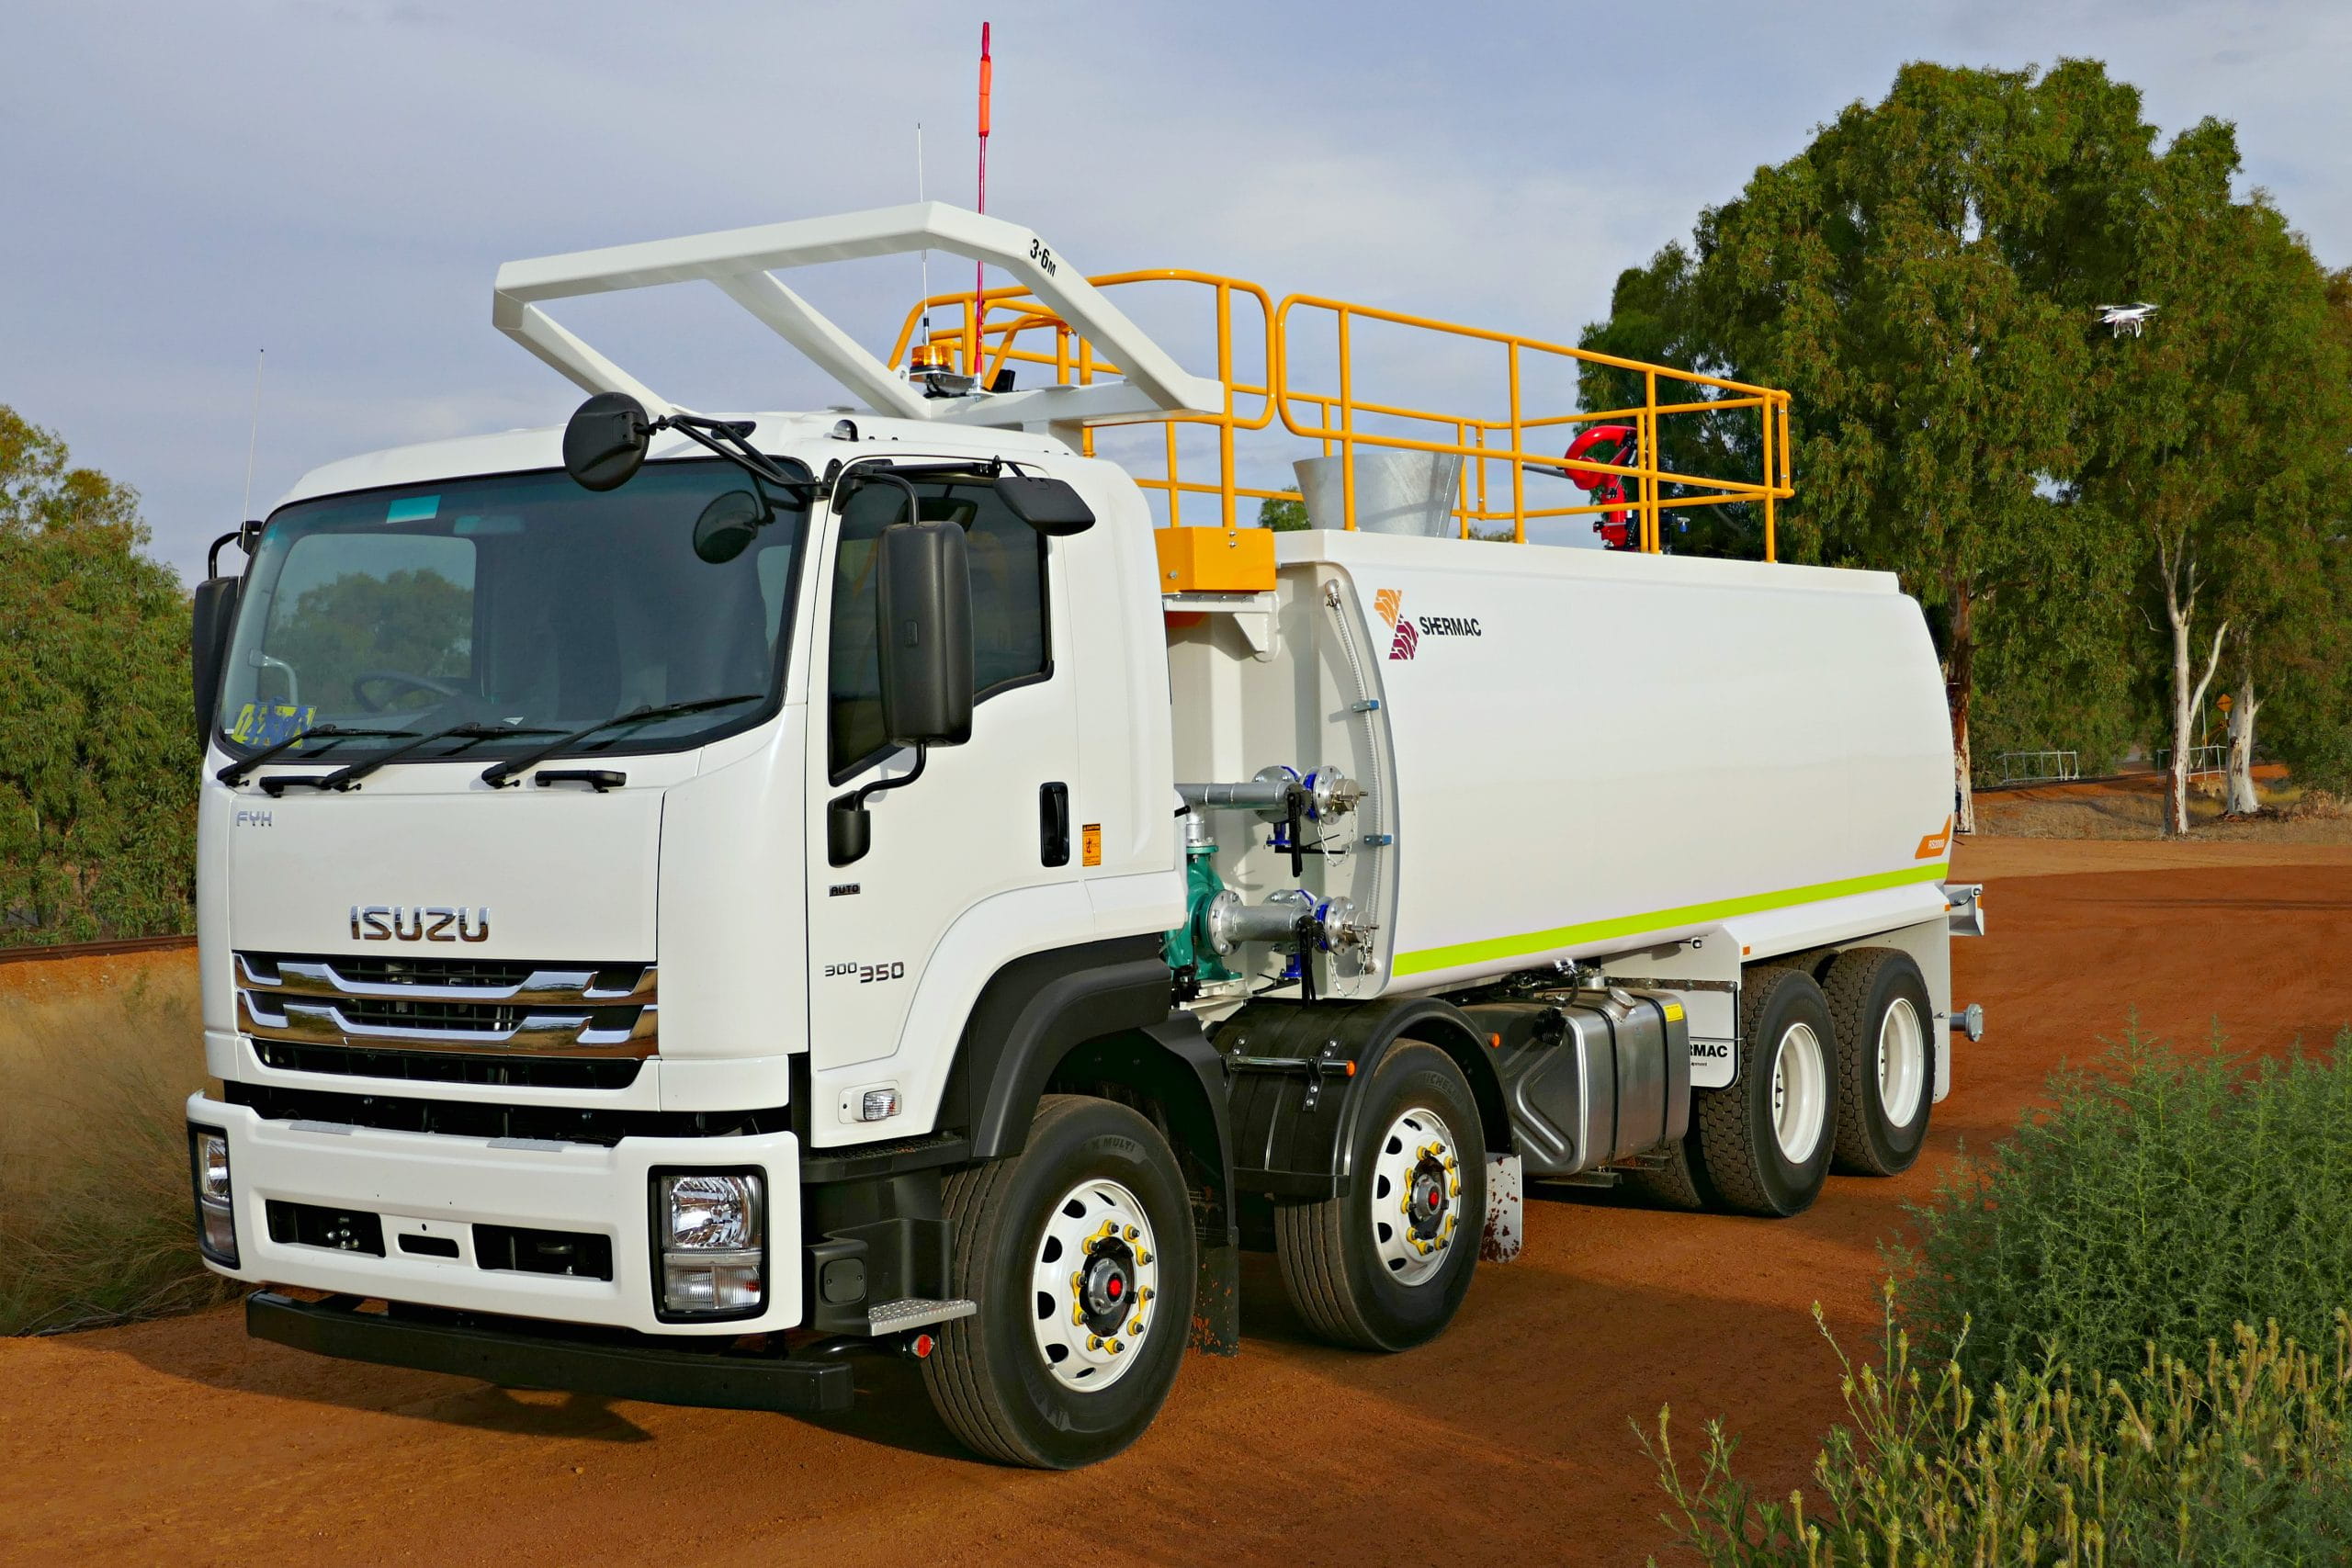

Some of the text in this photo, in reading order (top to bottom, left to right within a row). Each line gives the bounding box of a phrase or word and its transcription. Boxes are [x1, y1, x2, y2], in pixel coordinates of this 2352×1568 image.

[1419, 616, 1482, 637] SHERMAC
[236, 810, 273, 827] FYH
[830, 884, 860, 895] AUTO
[350, 905, 491, 942] ISUZU
[825, 962, 904, 984] 300 350
[1690, 1043, 1728, 1058] MAC
[1103, 1136, 1136, 1153] MULTI
